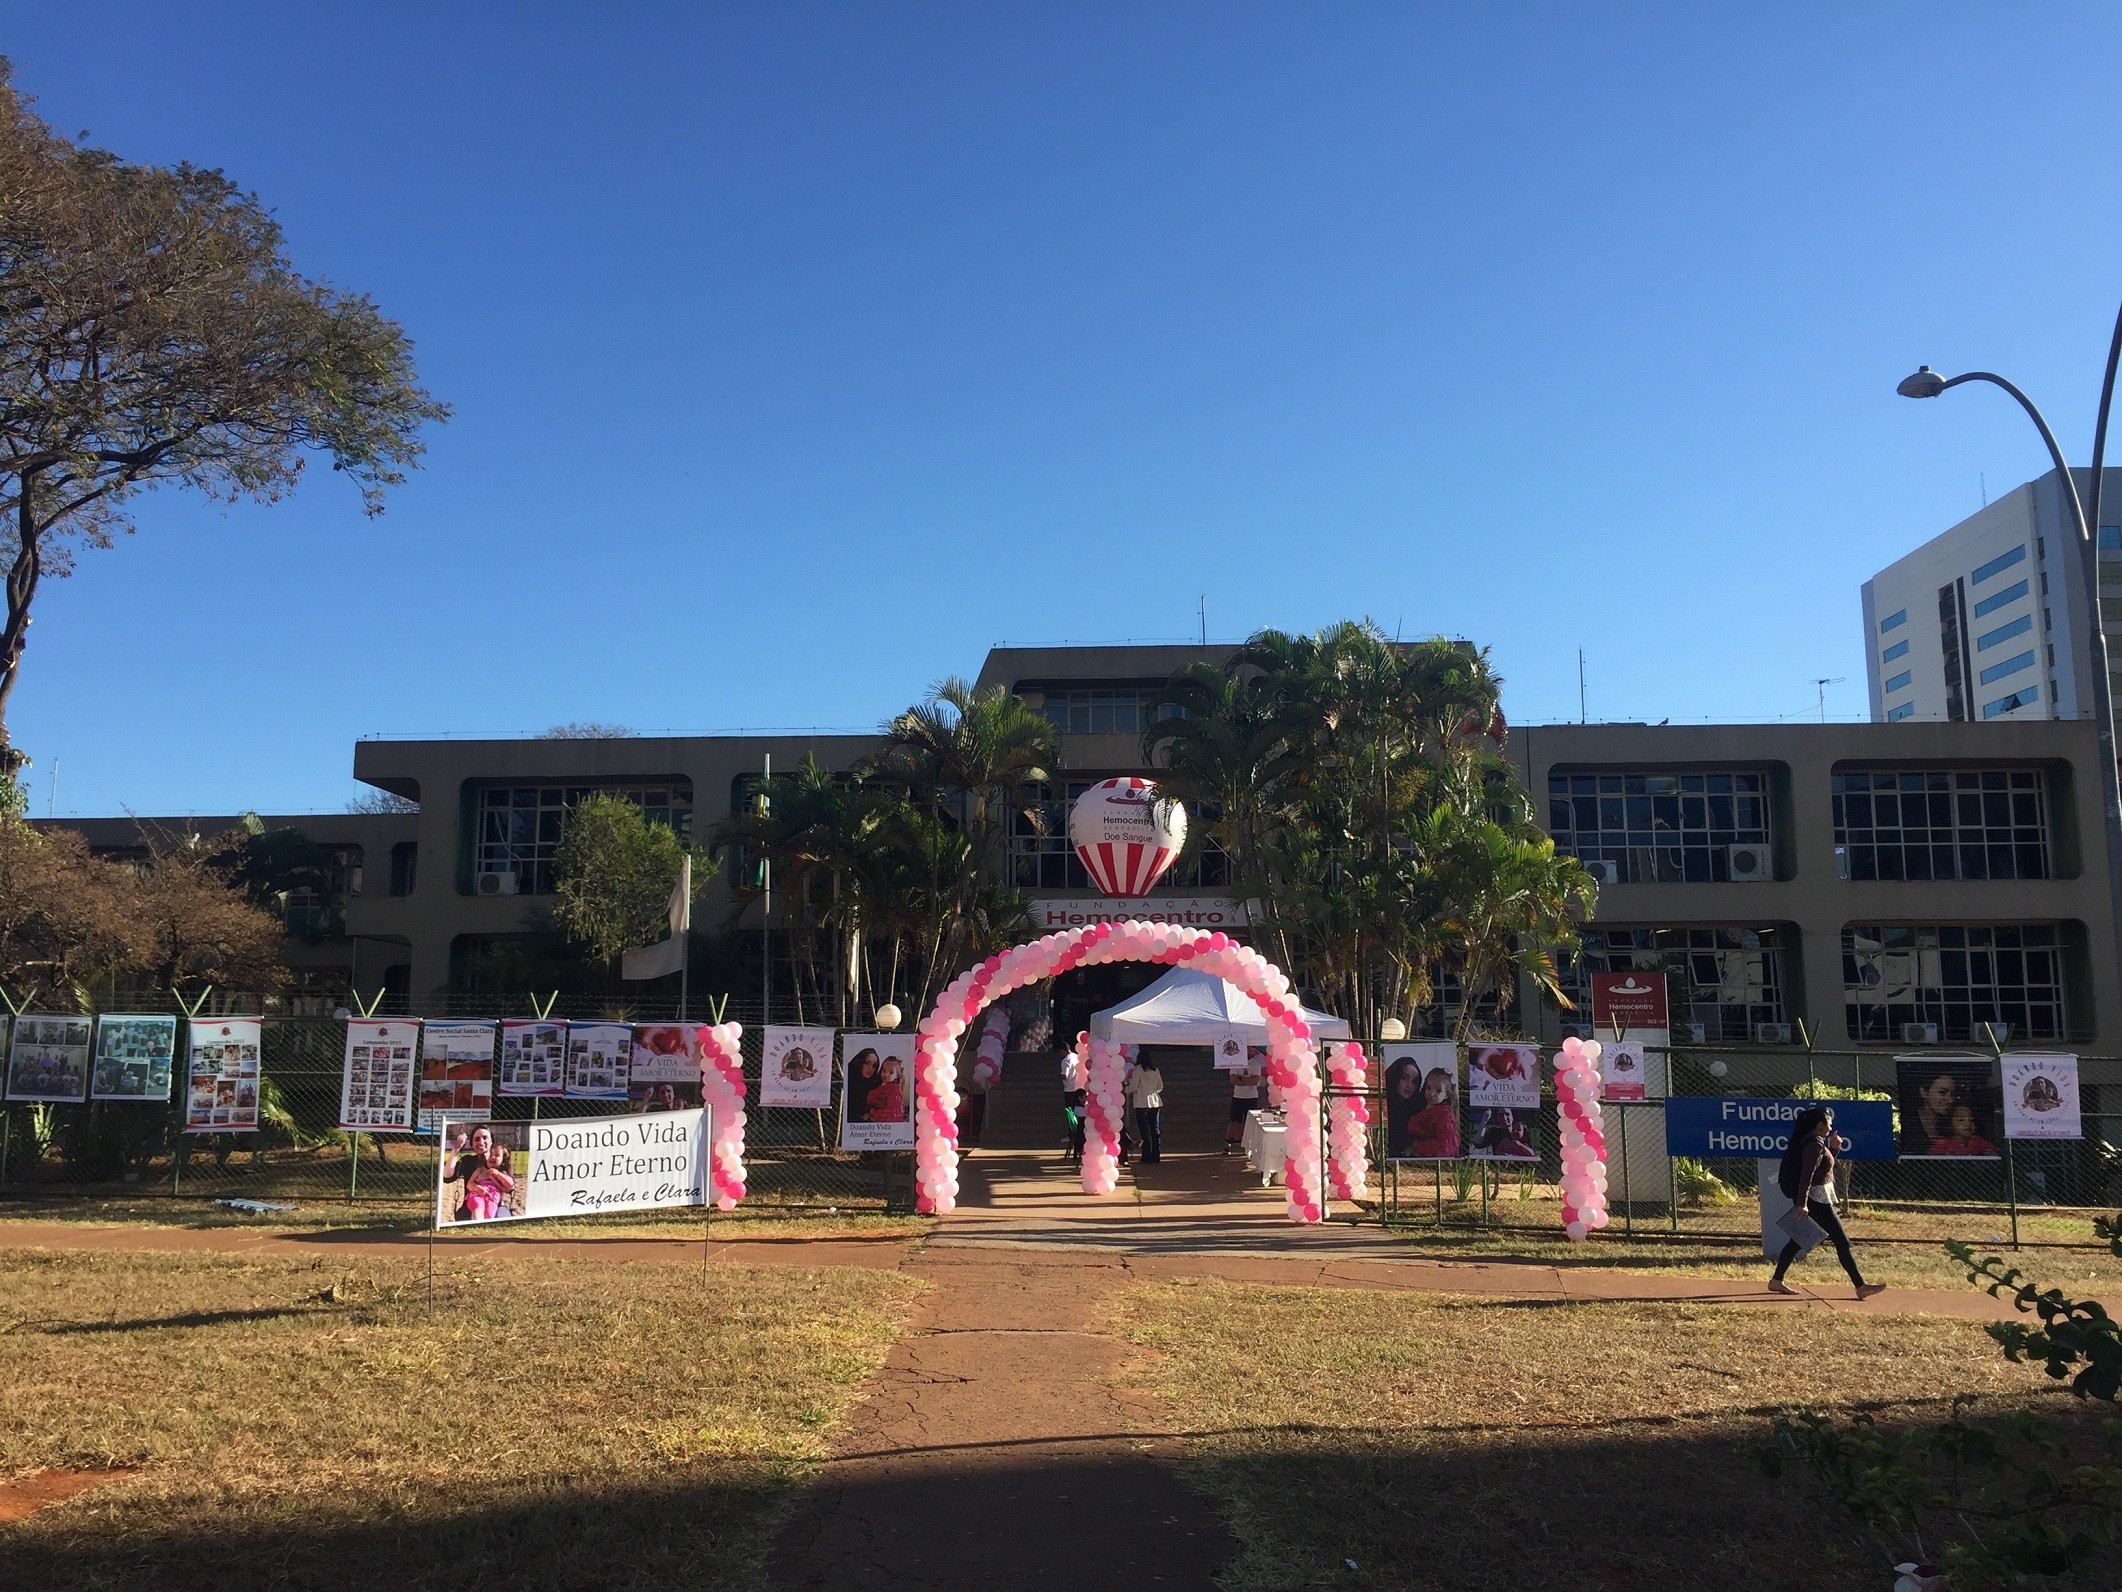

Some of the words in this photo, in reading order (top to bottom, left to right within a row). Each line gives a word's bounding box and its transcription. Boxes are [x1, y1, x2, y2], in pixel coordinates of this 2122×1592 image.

[1104, 832, 1120, 841] Doe
[1122, 832, 1153, 843] Sangue
[1046, 899, 1224, 909] FUNDAÇÃO
[1046, 909, 1224, 926] Hemocentro
[639, 1069, 663, 1077] AMOR
[665, 1069, 696, 1077] ETERNO
[1493, 1083, 1515, 1091] VIDA
[1501, 1095, 1535, 1103] ETERNO
[1722, 1101, 1835, 1120] Fundaço
[536, 1124, 630, 1151] Doando
[637, 1121, 687, 1145] Vida
[1708, 1131, 1852, 1152] Hemoco
[532, 1158, 602, 1183] Amor
[609, 1154, 687, 1176] Eterno
[570, 1188, 636, 1209] Rafaela
[641, 1191, 650, 1200] e
[653, 1183, 701, 1201] Clara
